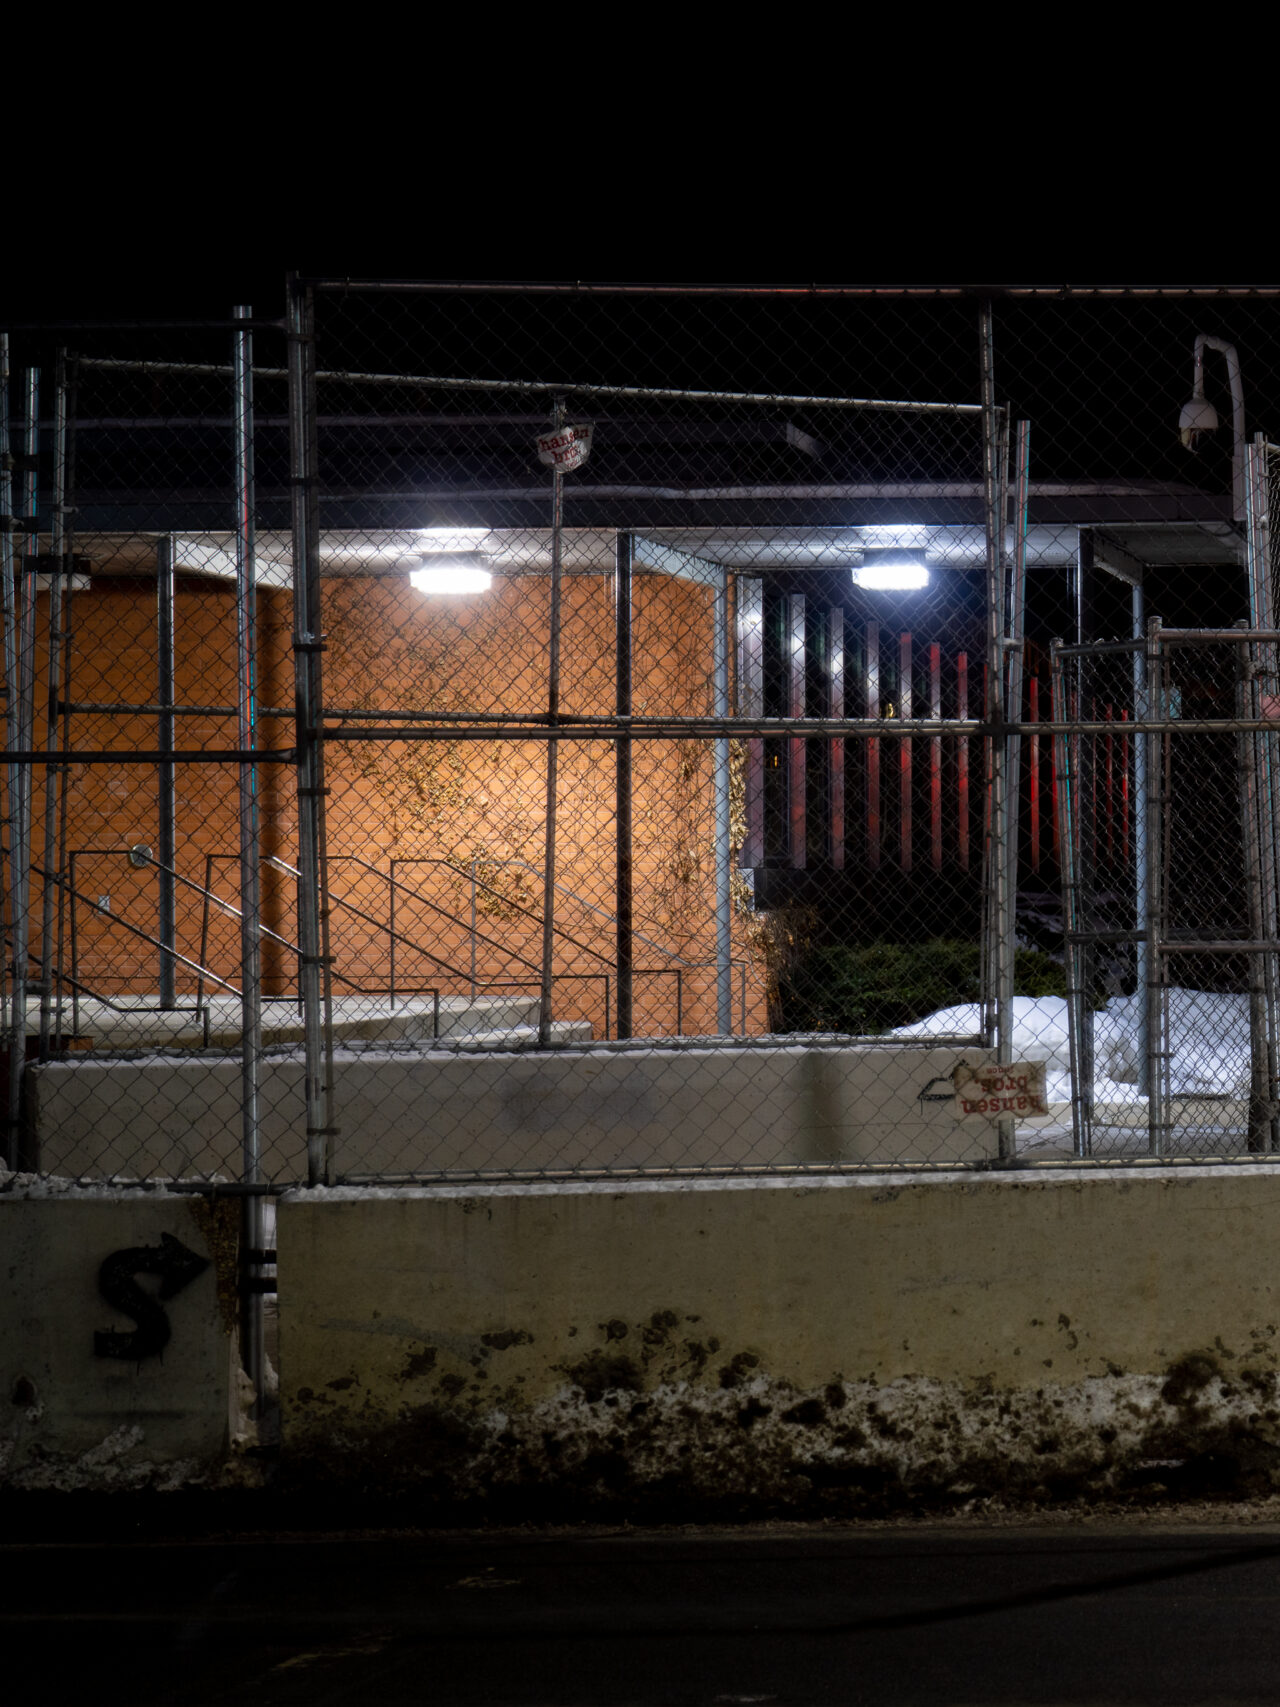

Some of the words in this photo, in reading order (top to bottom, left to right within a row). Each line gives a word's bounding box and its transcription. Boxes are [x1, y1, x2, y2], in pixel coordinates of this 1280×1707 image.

[539, 428, 588, 452] hansen
[975, 1075, 1030, 1093] bros.
[960, 1095, 1043, 1113] hansen
